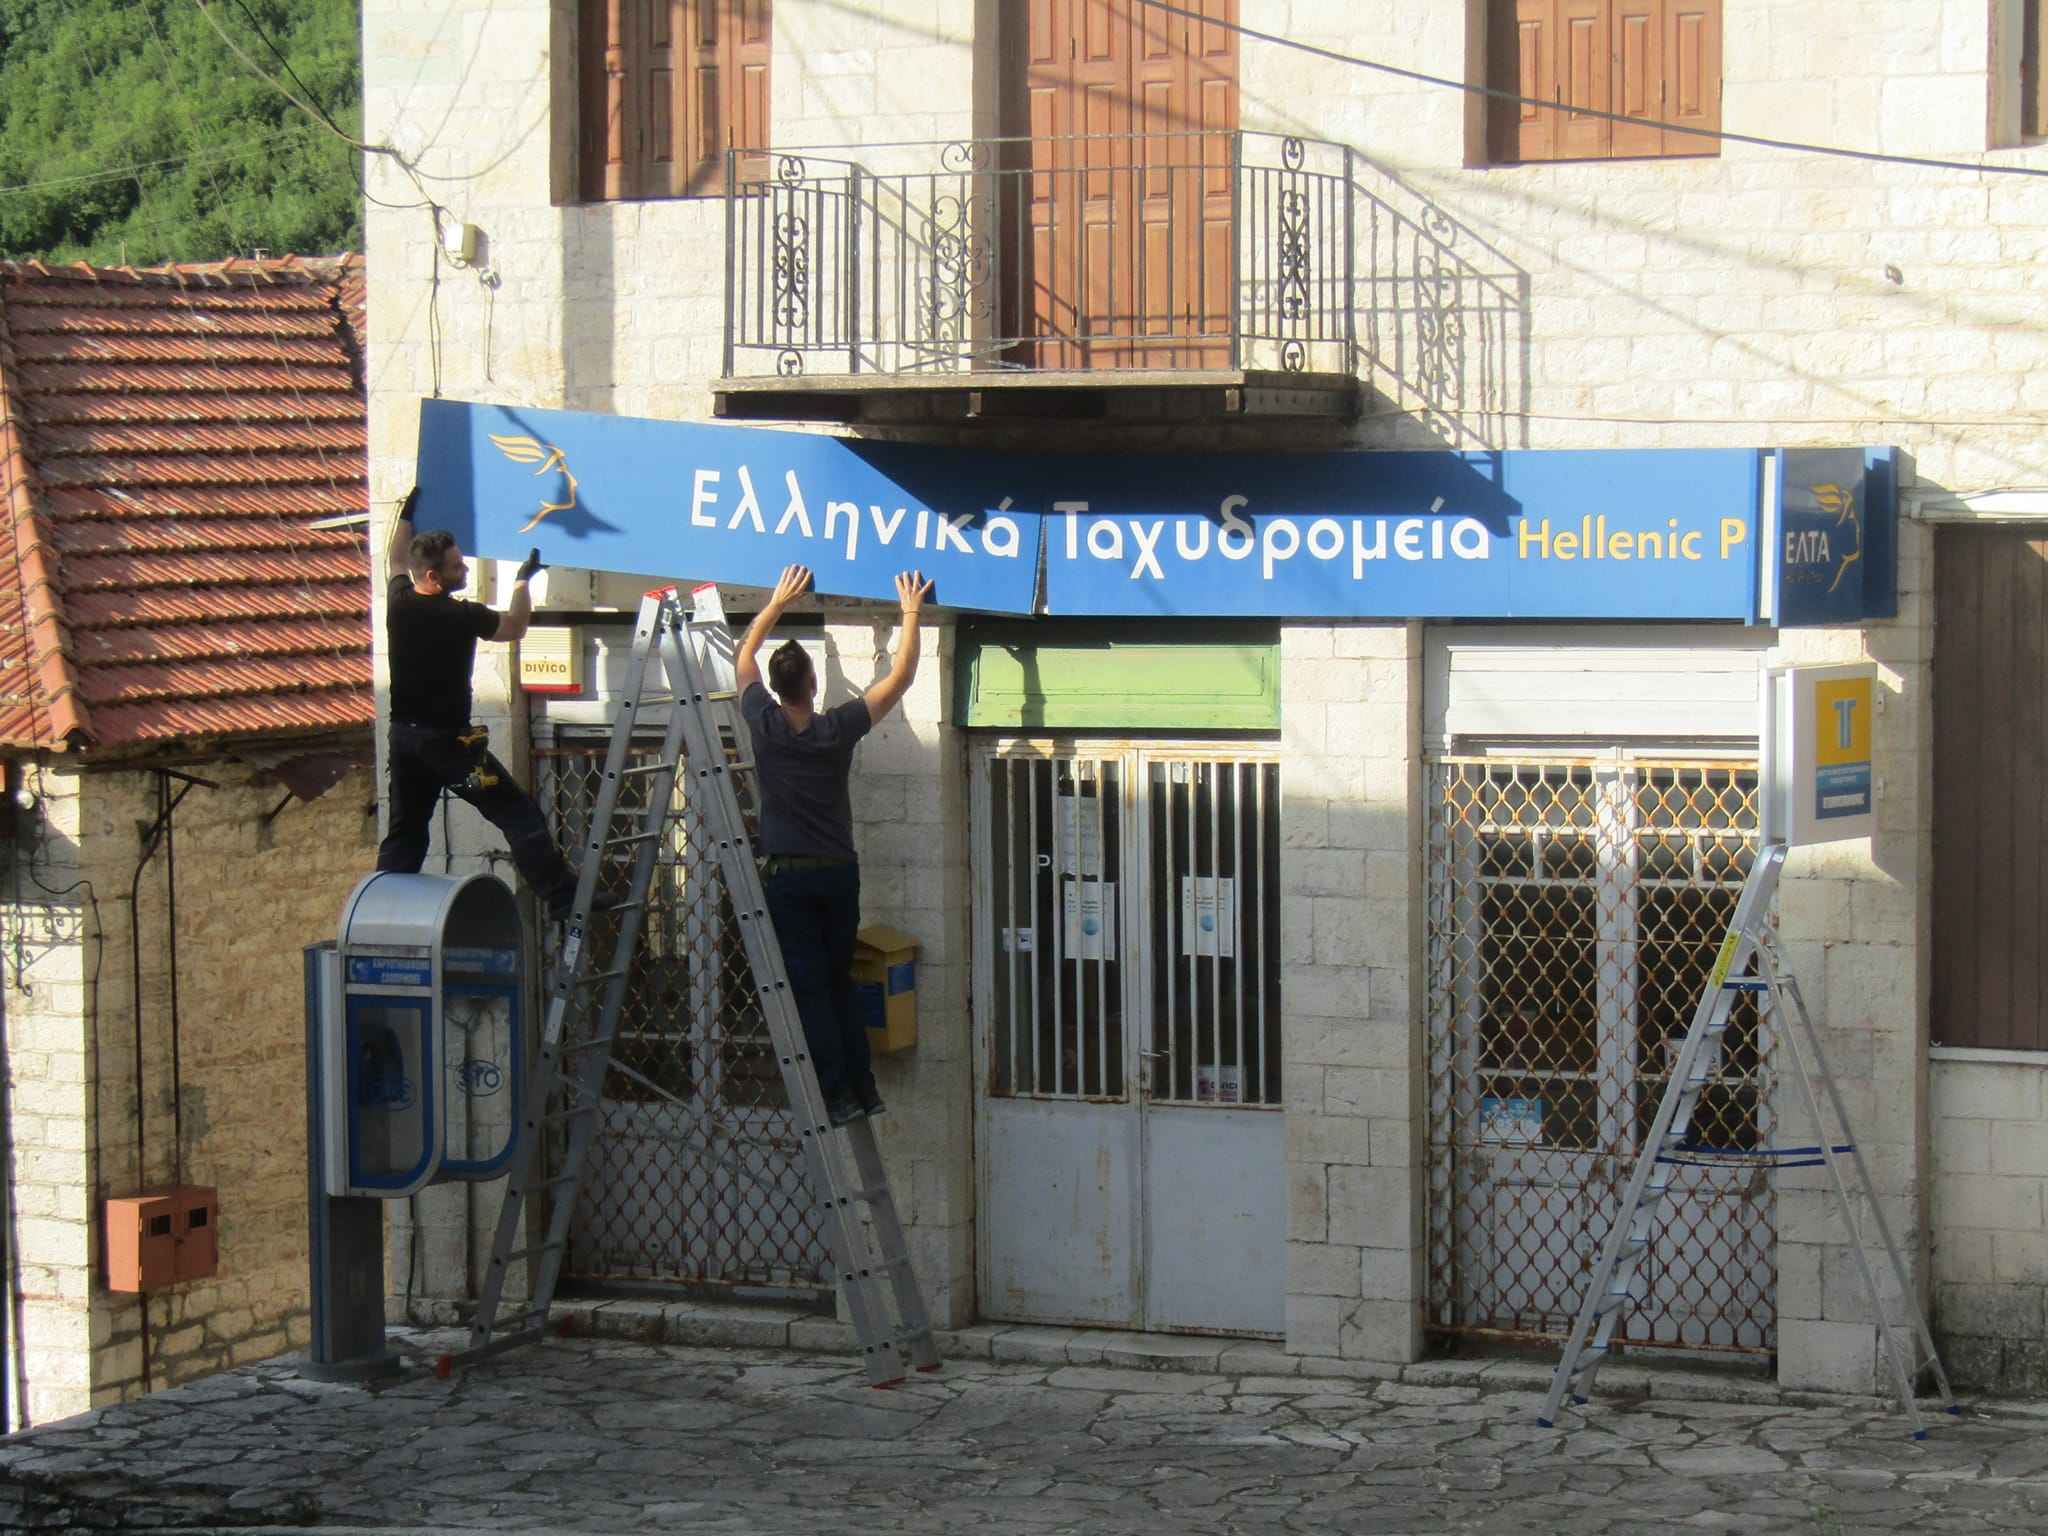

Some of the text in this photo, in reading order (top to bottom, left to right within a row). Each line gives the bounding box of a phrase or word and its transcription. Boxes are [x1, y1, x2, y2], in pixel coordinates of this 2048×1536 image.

[690, 464, 1490, 580] Ελληνικά Ταχυδρομεία
[1518, 515, 1747, 560] Hellenic P
